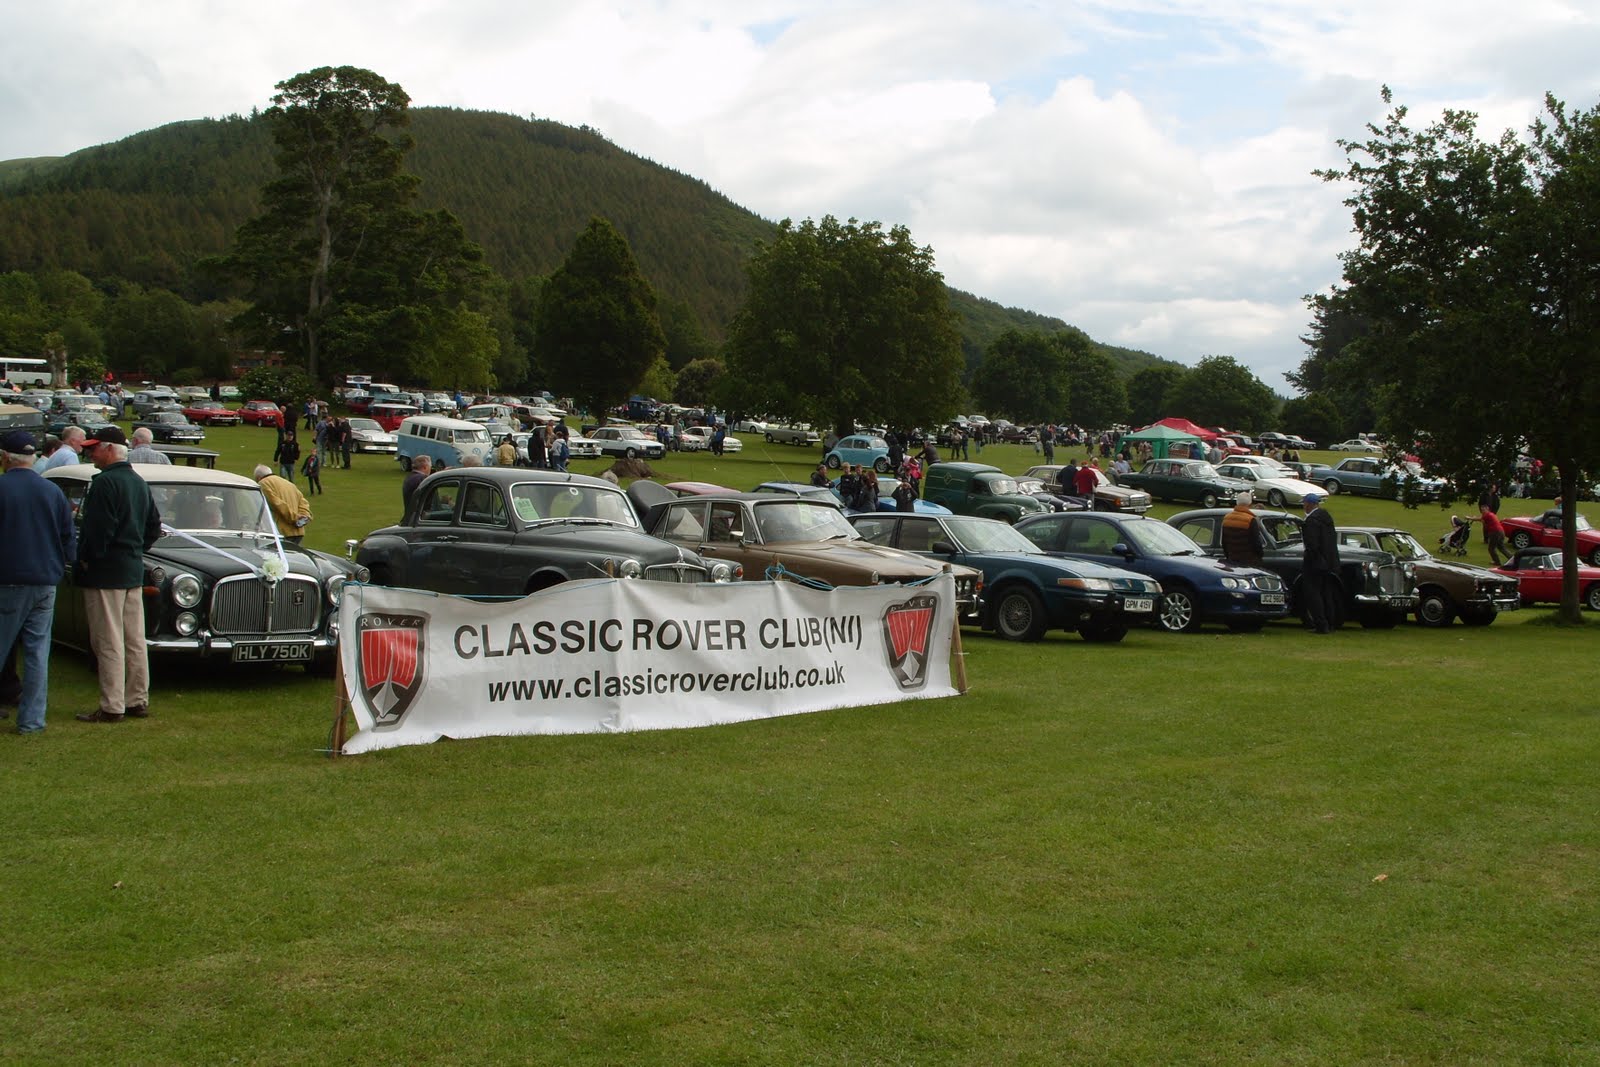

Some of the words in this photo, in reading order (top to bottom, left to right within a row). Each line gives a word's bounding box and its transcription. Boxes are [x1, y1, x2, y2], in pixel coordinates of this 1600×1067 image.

[1125, 600, 1138, 609] GPM
[361, 616, 420, 627] ROVER
[454, 619, 623, 660] CLASSIC
[632, 618, 747, 651] ROVER
[238, 645, 268, 660] HLY
[270, 644, 309, 659] 750K
[488, 660, 846, 702] www.classicroverclub.co.uk
